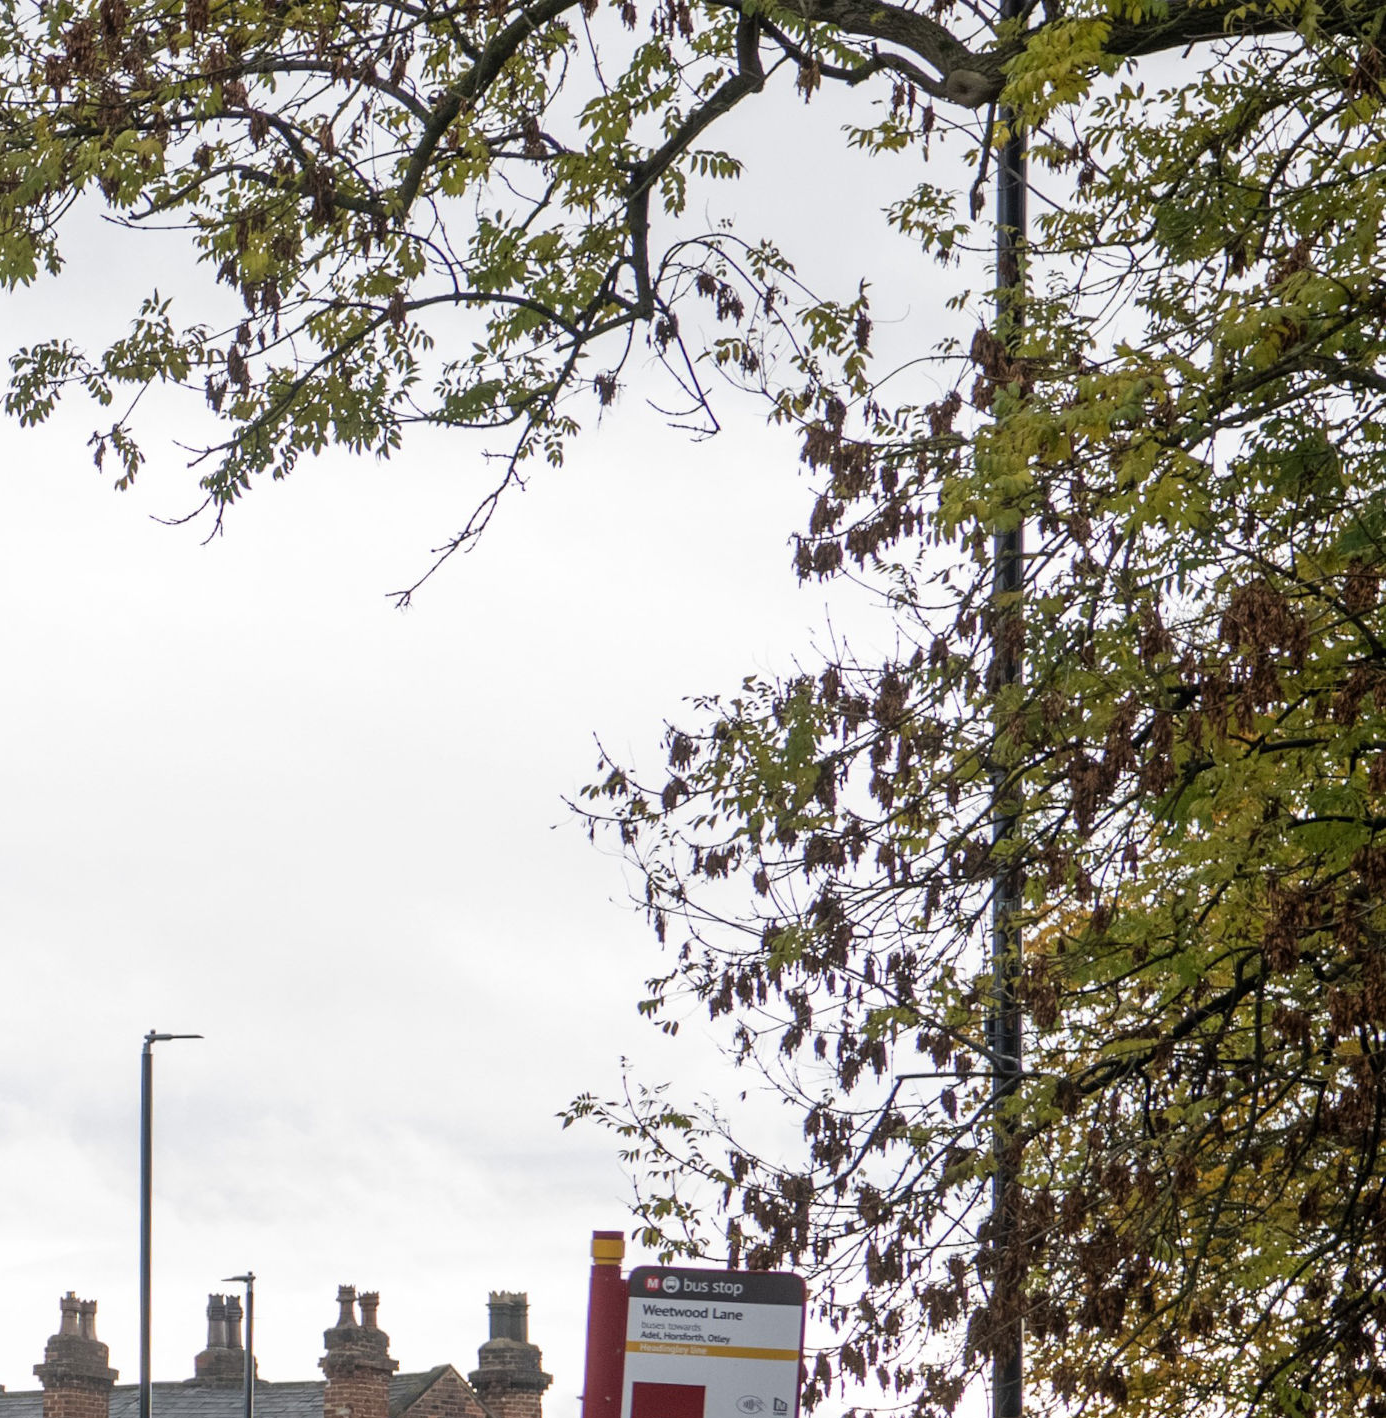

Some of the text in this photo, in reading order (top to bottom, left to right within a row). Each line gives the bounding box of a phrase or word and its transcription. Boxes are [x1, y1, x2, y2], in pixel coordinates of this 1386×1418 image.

[683, 1278, 743, 1296] bus stop
[642, 1304, 743, 1321] Weetwood Lane
[641, 1321, 702, 1332] buses towards
[708, 1334, 731, 1344] Otley
[639, 1343, 689, 1355] Headingley
